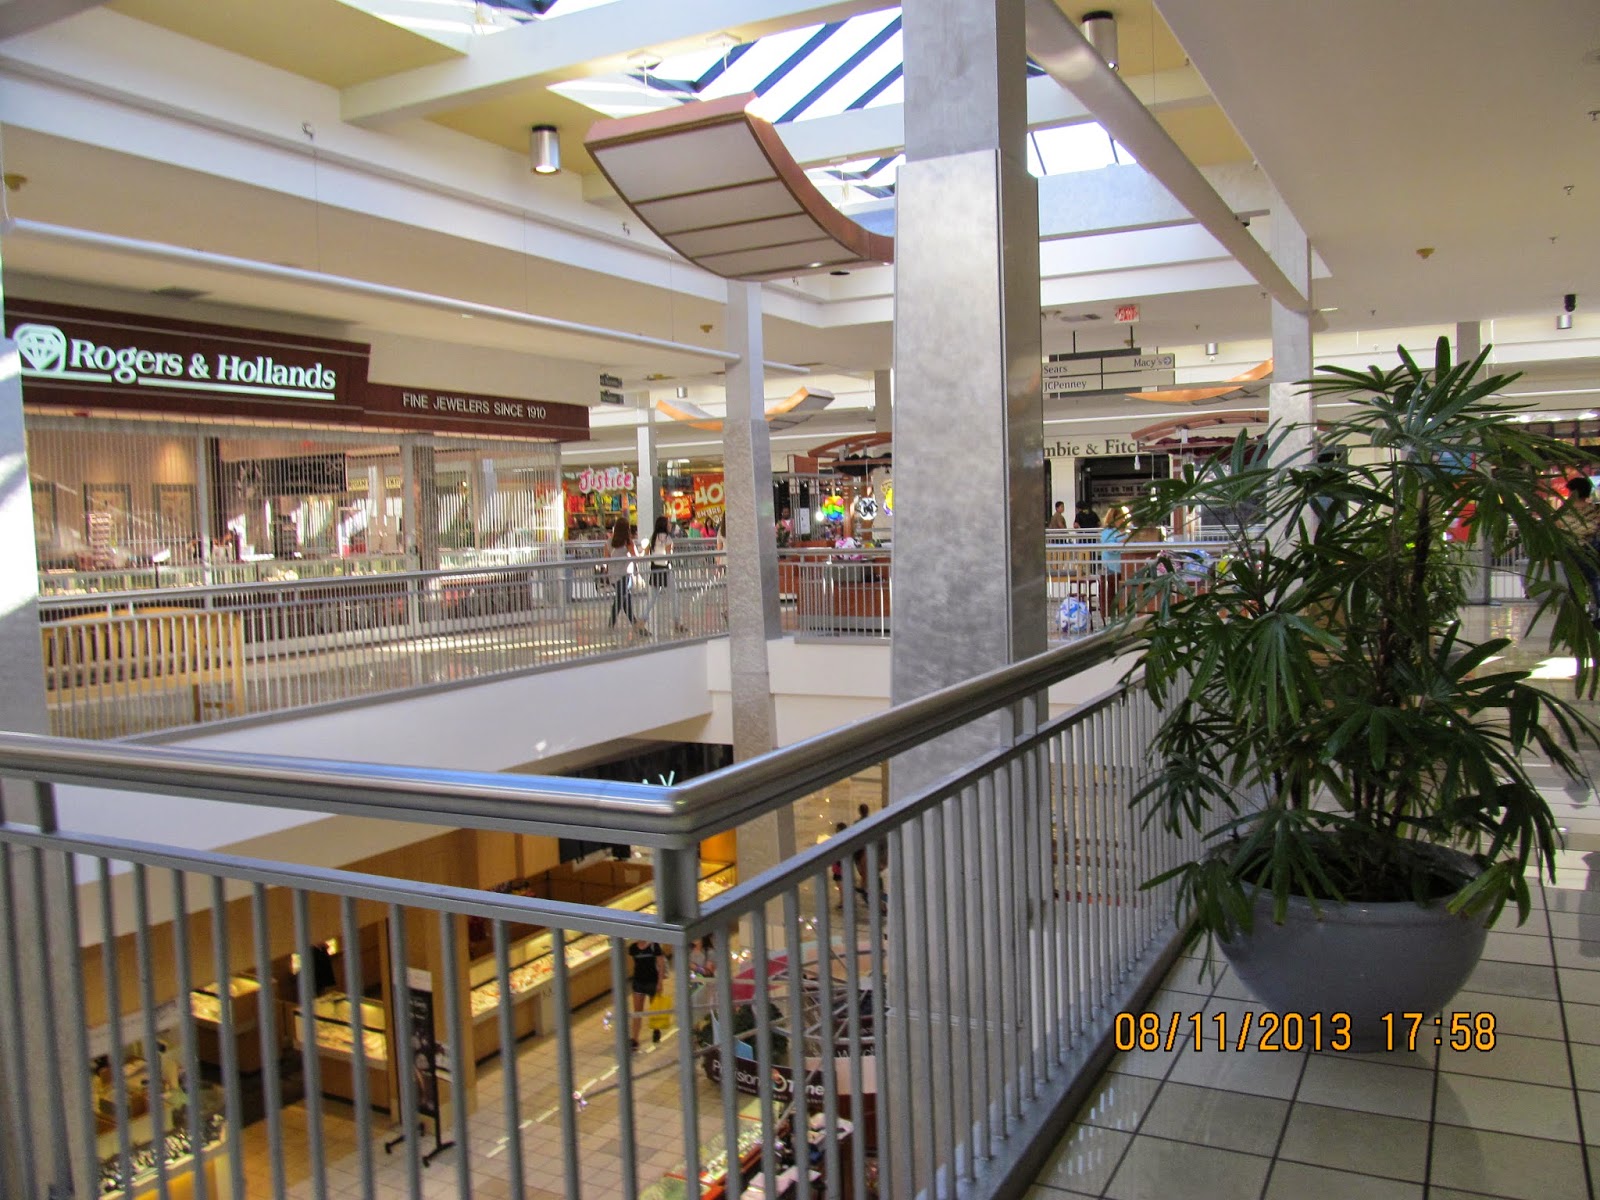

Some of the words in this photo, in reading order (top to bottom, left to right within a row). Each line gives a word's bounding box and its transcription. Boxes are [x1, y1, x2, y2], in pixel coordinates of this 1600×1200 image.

[69, 338, 183, 385] Rogers
[188, 352, 210, 379] &
[216, 353, 337, 390] Hollands
[1043, 364, 1068, 375] Sears
[1133, 357, 1163, 369] Macy's
[1043, 379, 1087, 393] JCPenney
[402, 391, 430, 410] FINE
[432, 395, 490, 415] JEWELERS
[493, 400, 524, 418] SINCE
[527, 405, 547, 420] 1910
[1085, 443, 1098, 455] &
[578, 466, 635, 495] Justice
